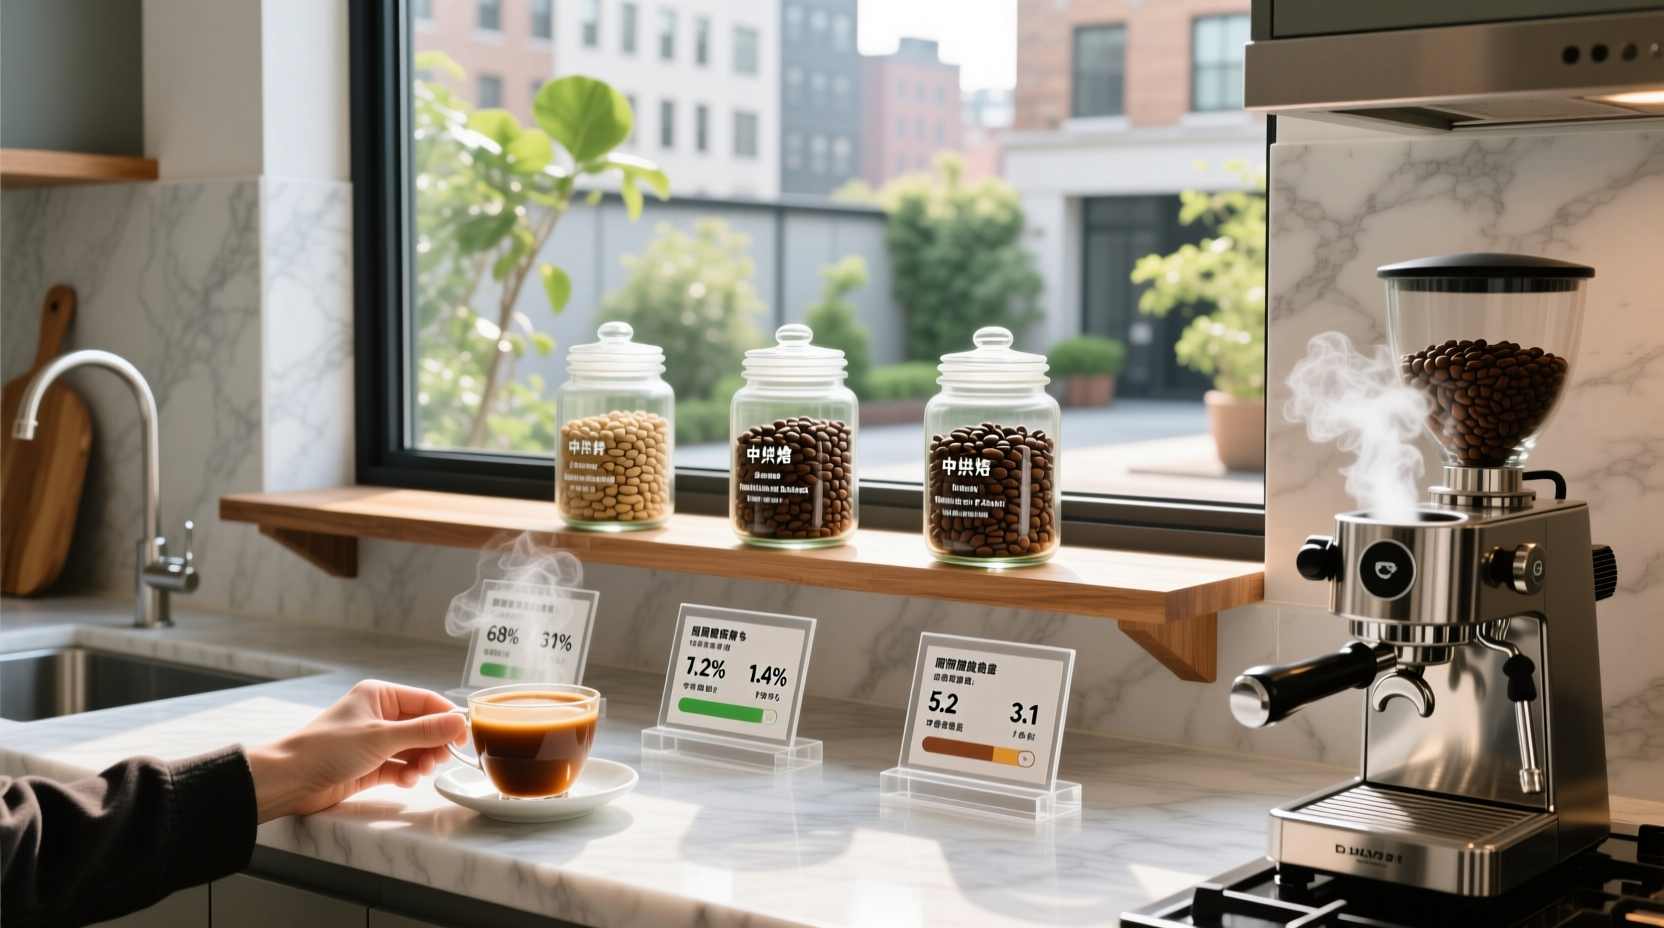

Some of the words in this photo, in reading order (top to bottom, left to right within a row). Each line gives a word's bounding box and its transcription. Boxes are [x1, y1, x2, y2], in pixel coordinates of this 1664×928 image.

[486, 624, 519, 645] 68%
[540, 631, 572, 652] 31%
[686, 656, 726, 679] 7.2%
[749, 664, 787, 687] 1.4%
[928, 690, 959, 715] 5.2
[1009, 702, 1039, 725] 3.1
